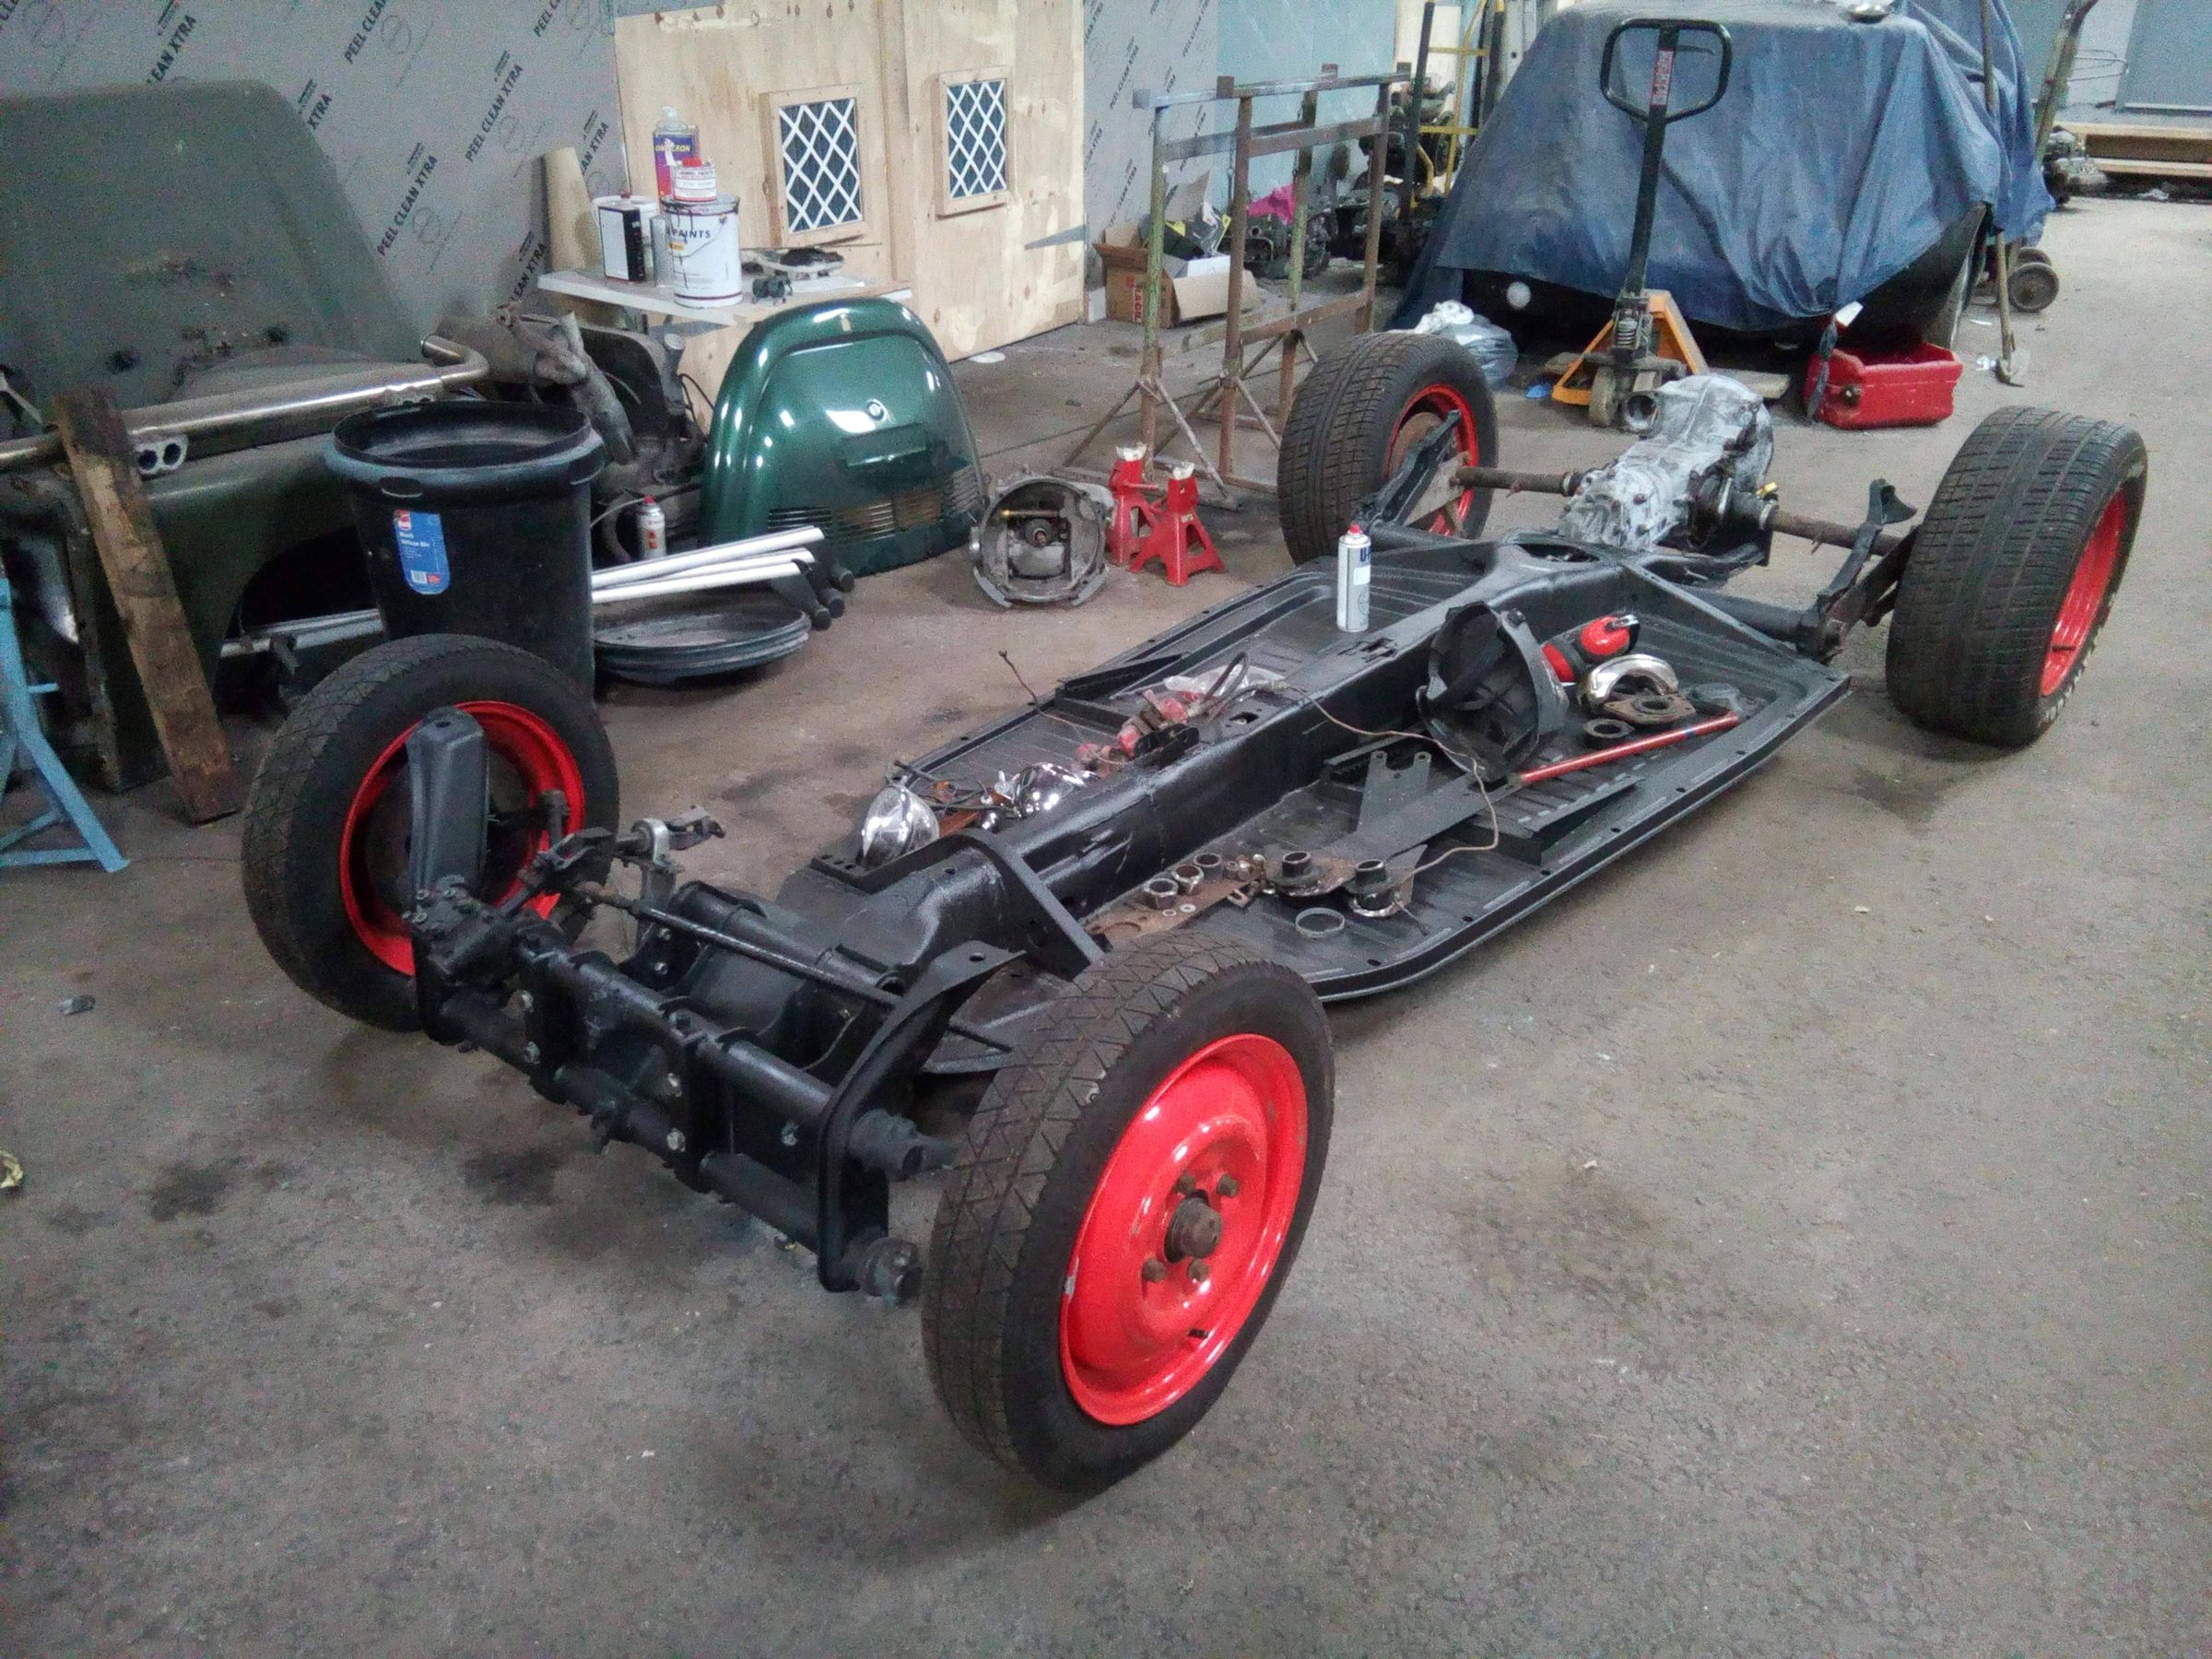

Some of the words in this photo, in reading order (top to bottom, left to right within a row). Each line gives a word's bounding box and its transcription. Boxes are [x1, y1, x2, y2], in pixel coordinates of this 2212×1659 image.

[533, 9, 553, 38] PEEL
[146, 50, 174, 83] EAN
[168, 15, 197, 53] XTRA
[344, 32, 367, 65] PEEL
[307, 94, 333, 130] XTRA
[465, 134, 486, 163] PEEL
[481, 94, 506, 134] CLEAN
[500, 64, 524, 97] XTRA
[589, 122, 609, 153] XTRA
[377, 228, 399, 256] PEEL
[394, 186, 419, 226] CLEAN
[415, 155, 438, 188] XTRA
[525, 242, 547, 274] XTRA
